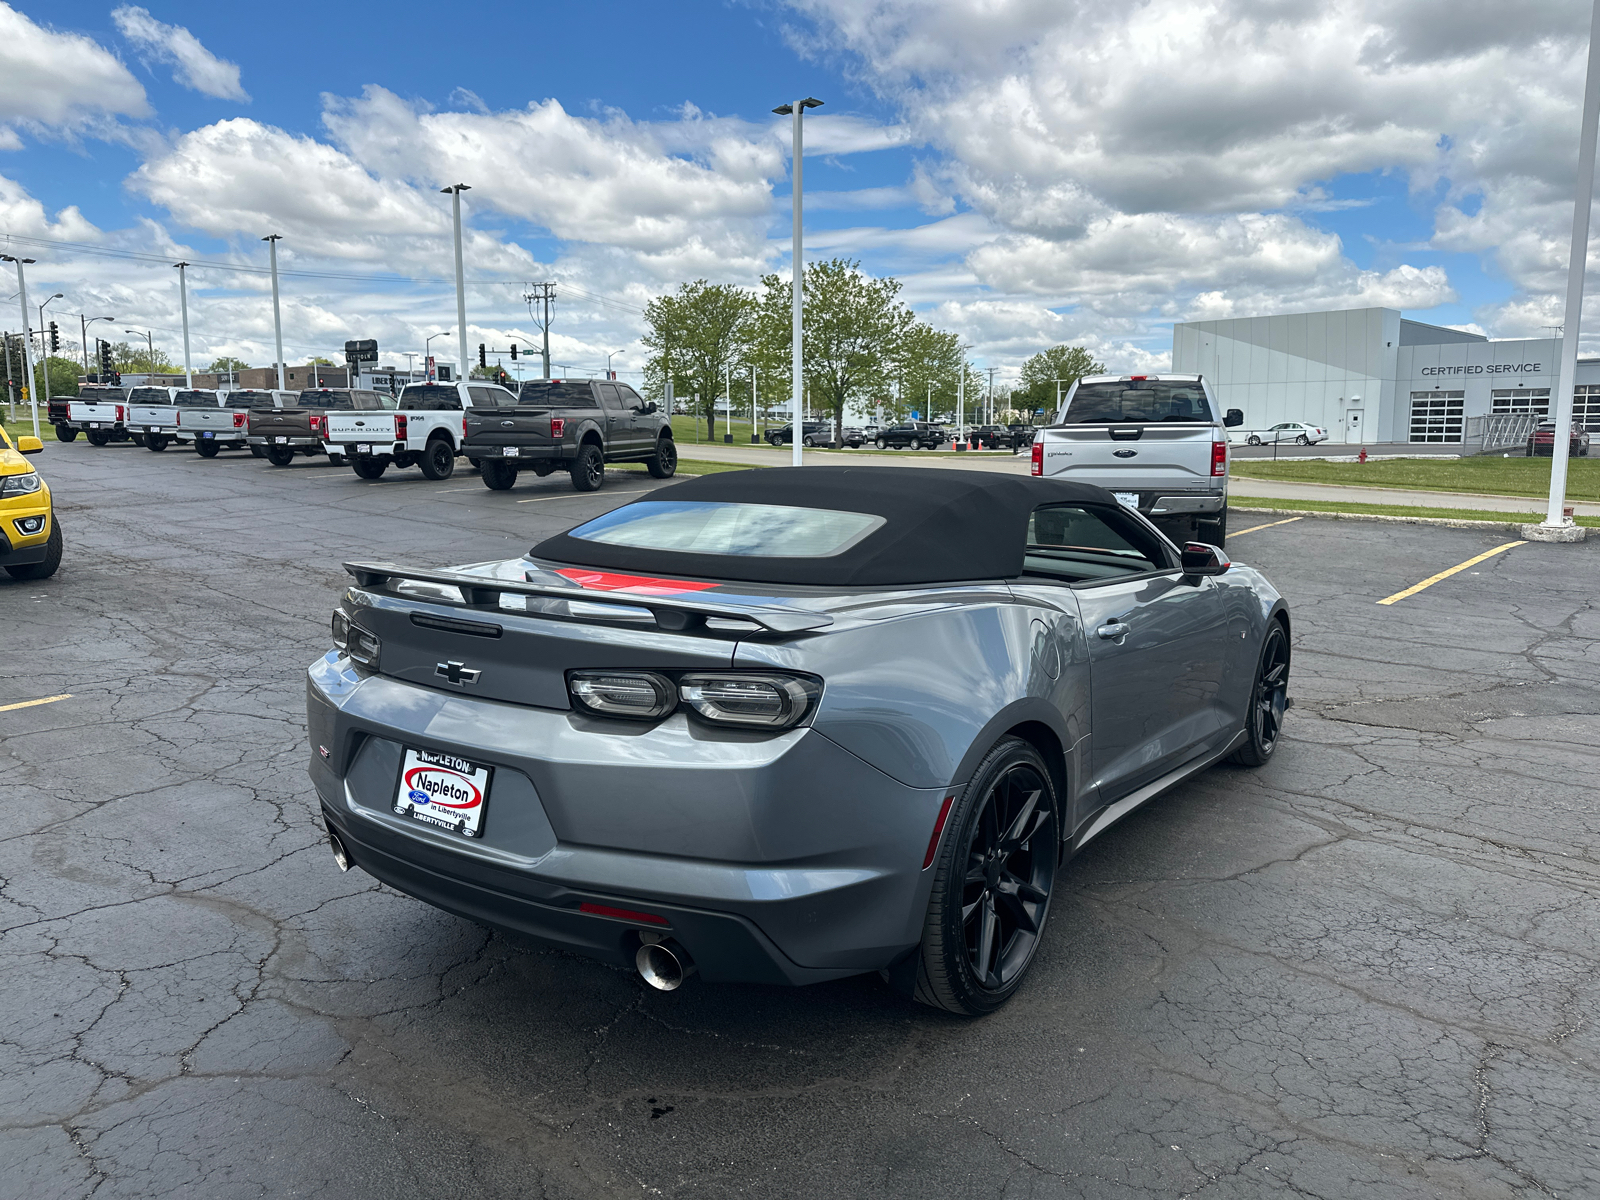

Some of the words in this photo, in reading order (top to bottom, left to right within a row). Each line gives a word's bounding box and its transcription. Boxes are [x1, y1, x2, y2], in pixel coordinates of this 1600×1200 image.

[1421, 365, 1483, 375] CERTIFIED
[1486, 363, 1541, 373] SERVICE
[421, 750, 470, 773] NAPLETON
[416, 772, 469, 802] Napleton
[411, 791, 427, 804] Ford
[413, 812, 455, 831] LIBERTYVILLE
[438, 806, 471, 821] Libertyville
